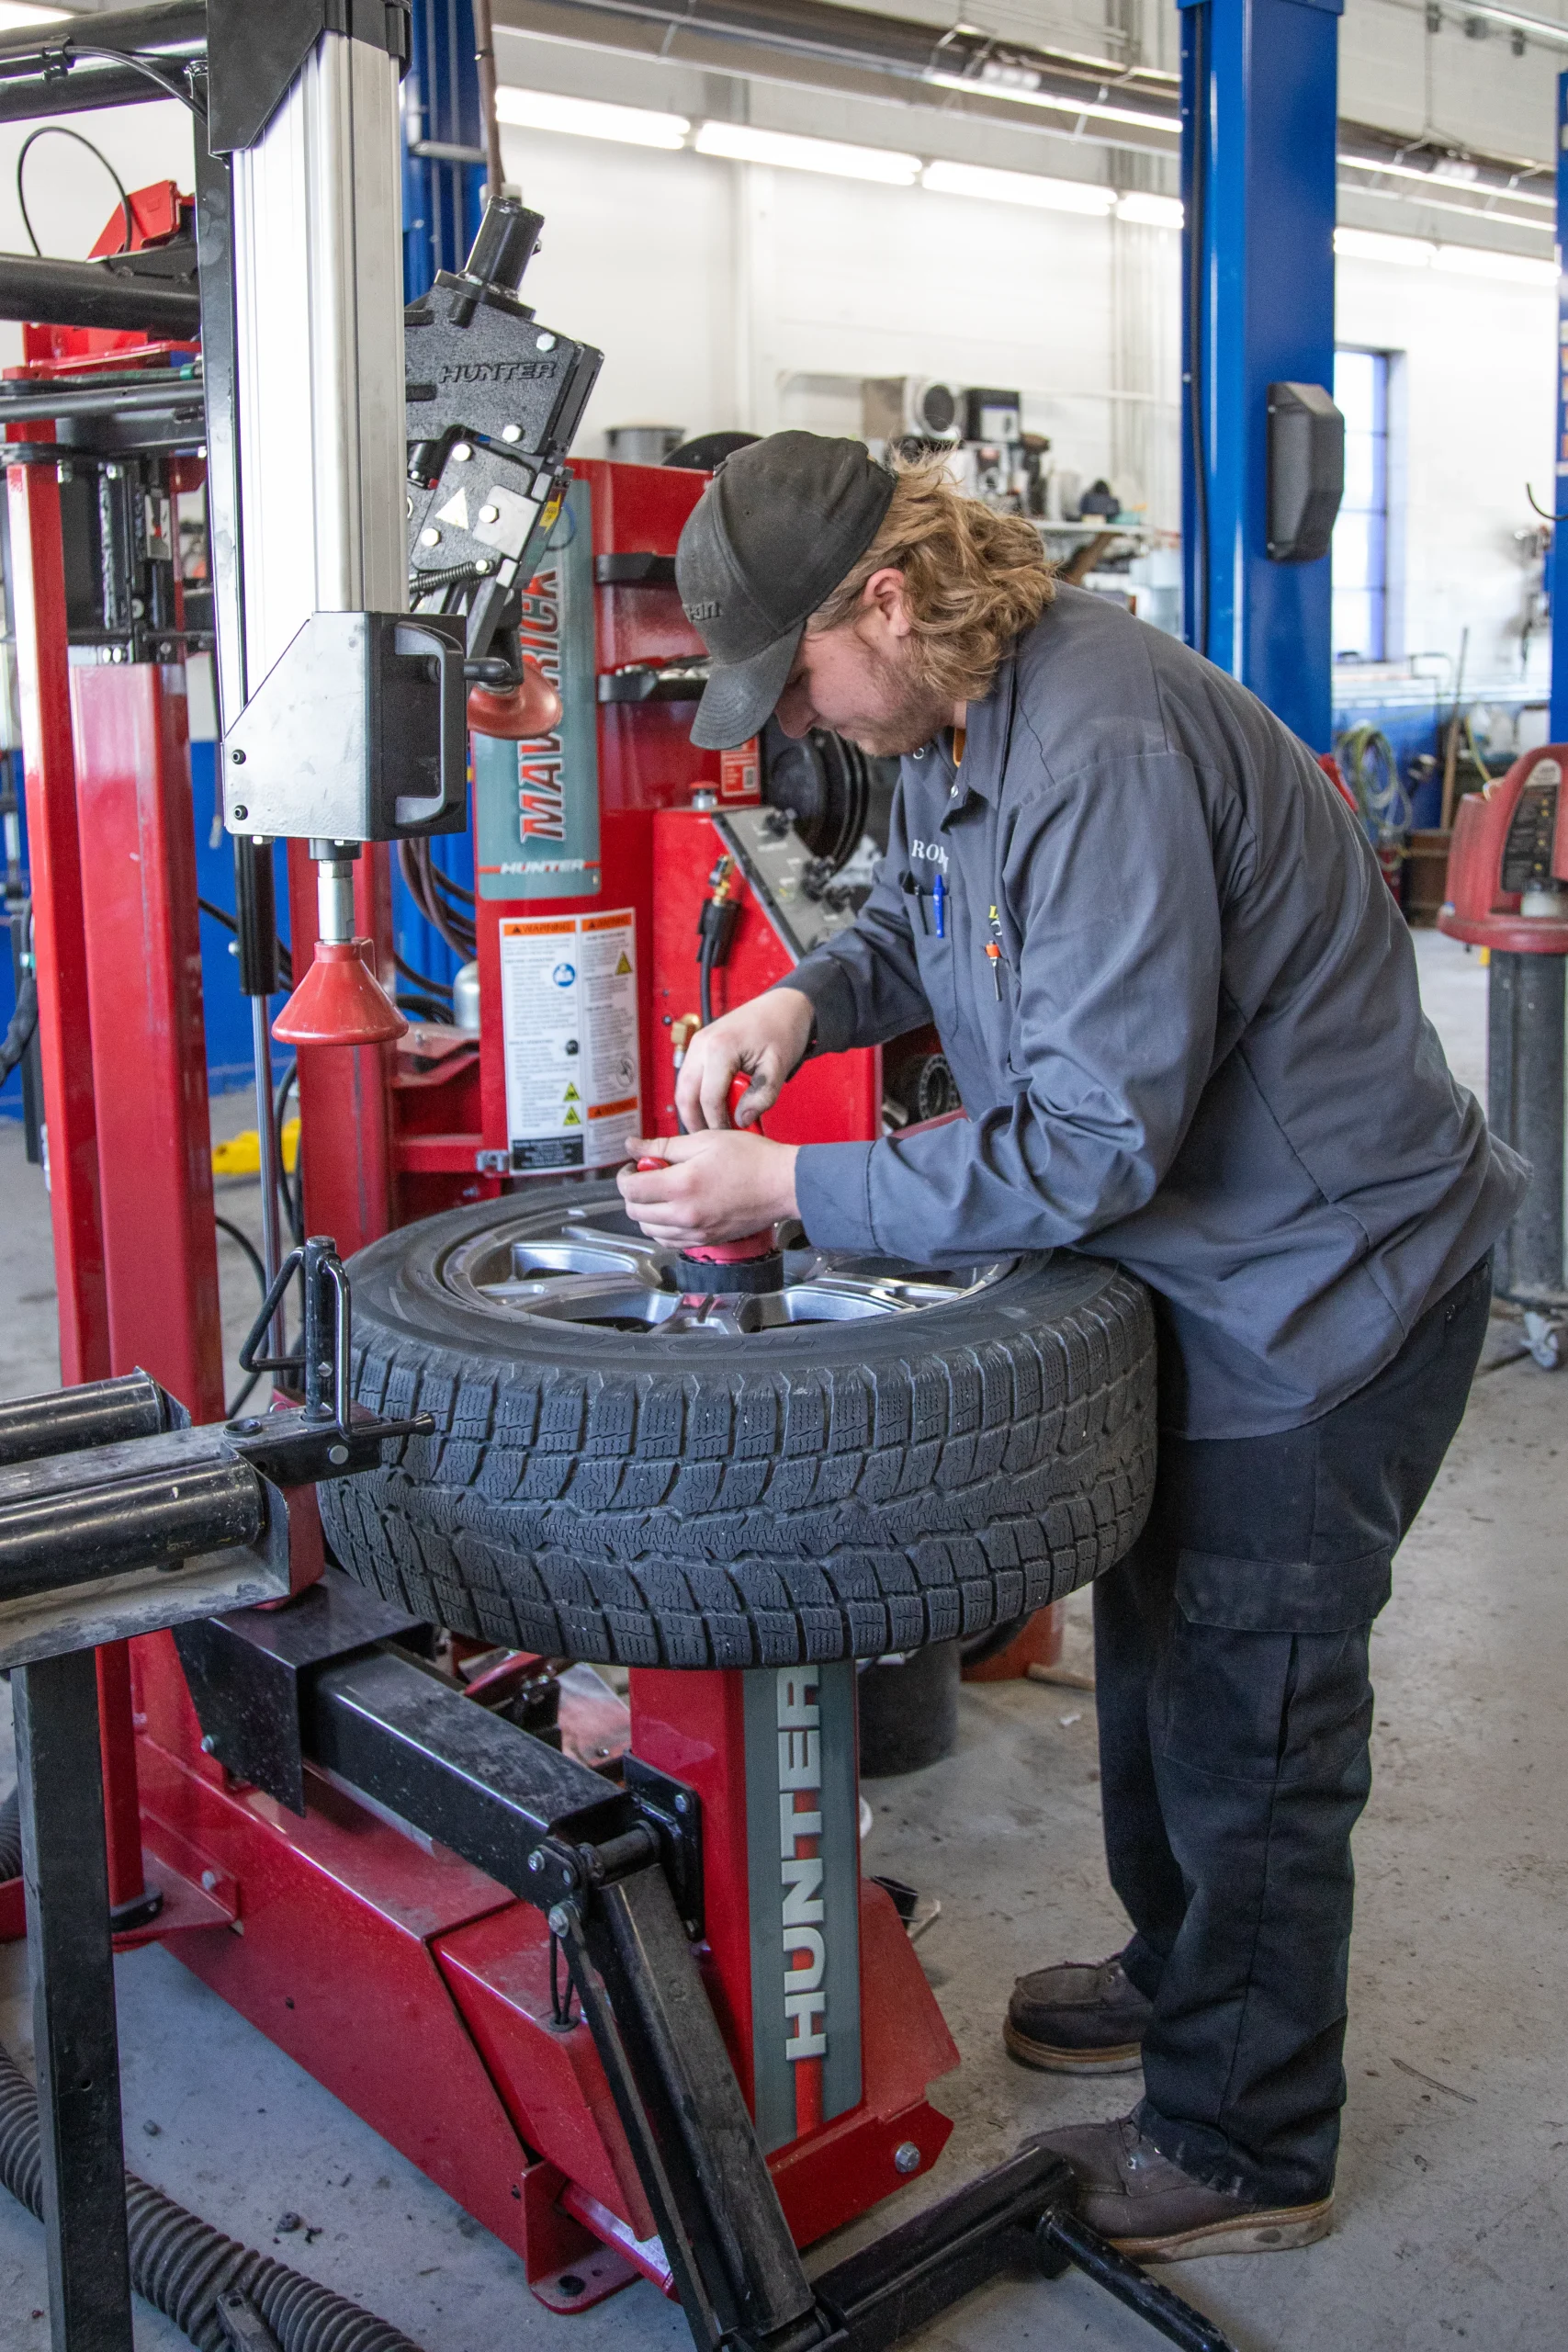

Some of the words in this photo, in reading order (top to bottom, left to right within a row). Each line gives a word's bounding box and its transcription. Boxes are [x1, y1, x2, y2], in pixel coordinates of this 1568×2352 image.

[438, 360, 557, 384] HUNTER
[518, 567, 567, 844] MAVRICK
[501, 858, 584, 875] HUNTER
[776, 1665, 827, 2062] HUNTER
